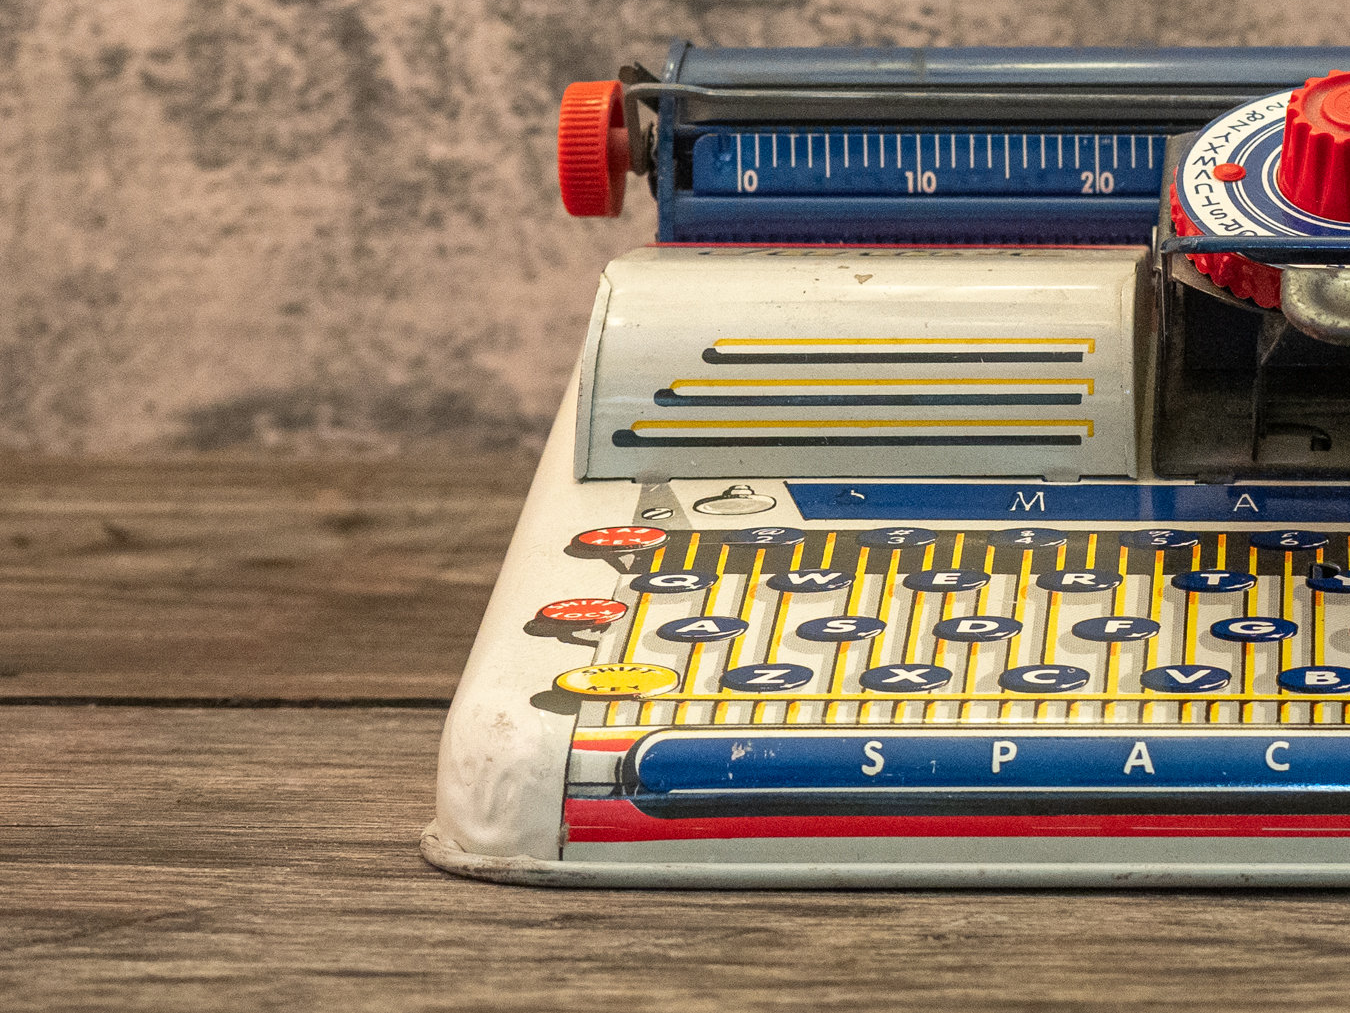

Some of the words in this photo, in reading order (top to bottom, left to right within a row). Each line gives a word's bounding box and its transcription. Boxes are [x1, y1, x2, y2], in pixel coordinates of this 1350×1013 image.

[1213, 132, 1231, 143] Y
[1203, 142, 1226, 155] X
[905, 170, 937, 194] 10
[1081, 170, 1114, 194] 20
[1210, 208, 1228, 220] S
[1218, 218, 1244, 231] R
[649, 574, 703, 589] Q
[787, 571, 843, 586] W
[931, 572, 962, 585] E
[1060, 573, 1097, 586] R
[1199, 573, 1231, 585] T
[674, 618, 722, 634] A
[822, 618, 859, 634] S
[956, 619, 999, 634] D
[1104, 620, 1134, 634] F
[1239, 620, 1277, 635] G
[753, 668, 792, 684] Z
[887, 668, 931, 684] X
[1021, 668, 1060, 684] C
[1164, 669, 1212, 684] V
[1304, 669, 1342, 686] B
